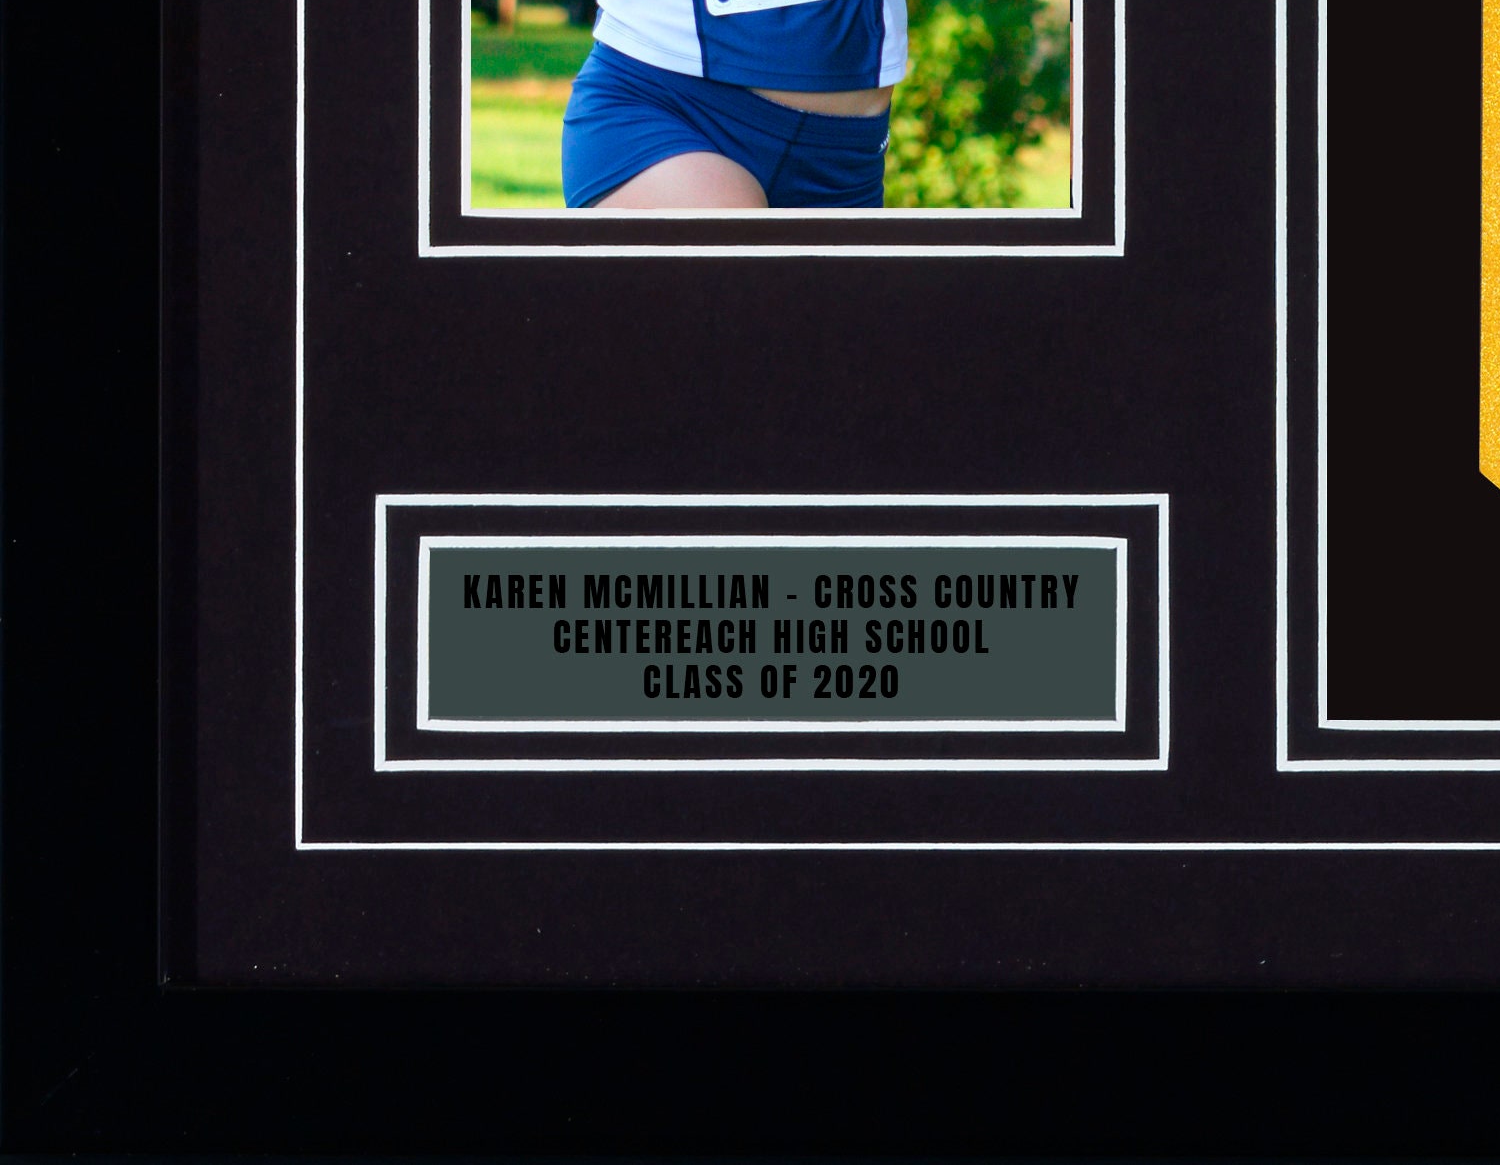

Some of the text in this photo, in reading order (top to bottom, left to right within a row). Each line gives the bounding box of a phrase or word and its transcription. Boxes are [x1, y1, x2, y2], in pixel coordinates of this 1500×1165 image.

[463, 574, 566, 609] KAREN
[583, 574, 769, 609] MCMILLIAN
[814, 574, 917, 609] CROSS
[934, 574, 1080, 609] COUNTRY
[553, 619, 989, 654] CENTEREACH HIGH SCHOOL
[643, 664, 899, 699] CLASS OF 2020
